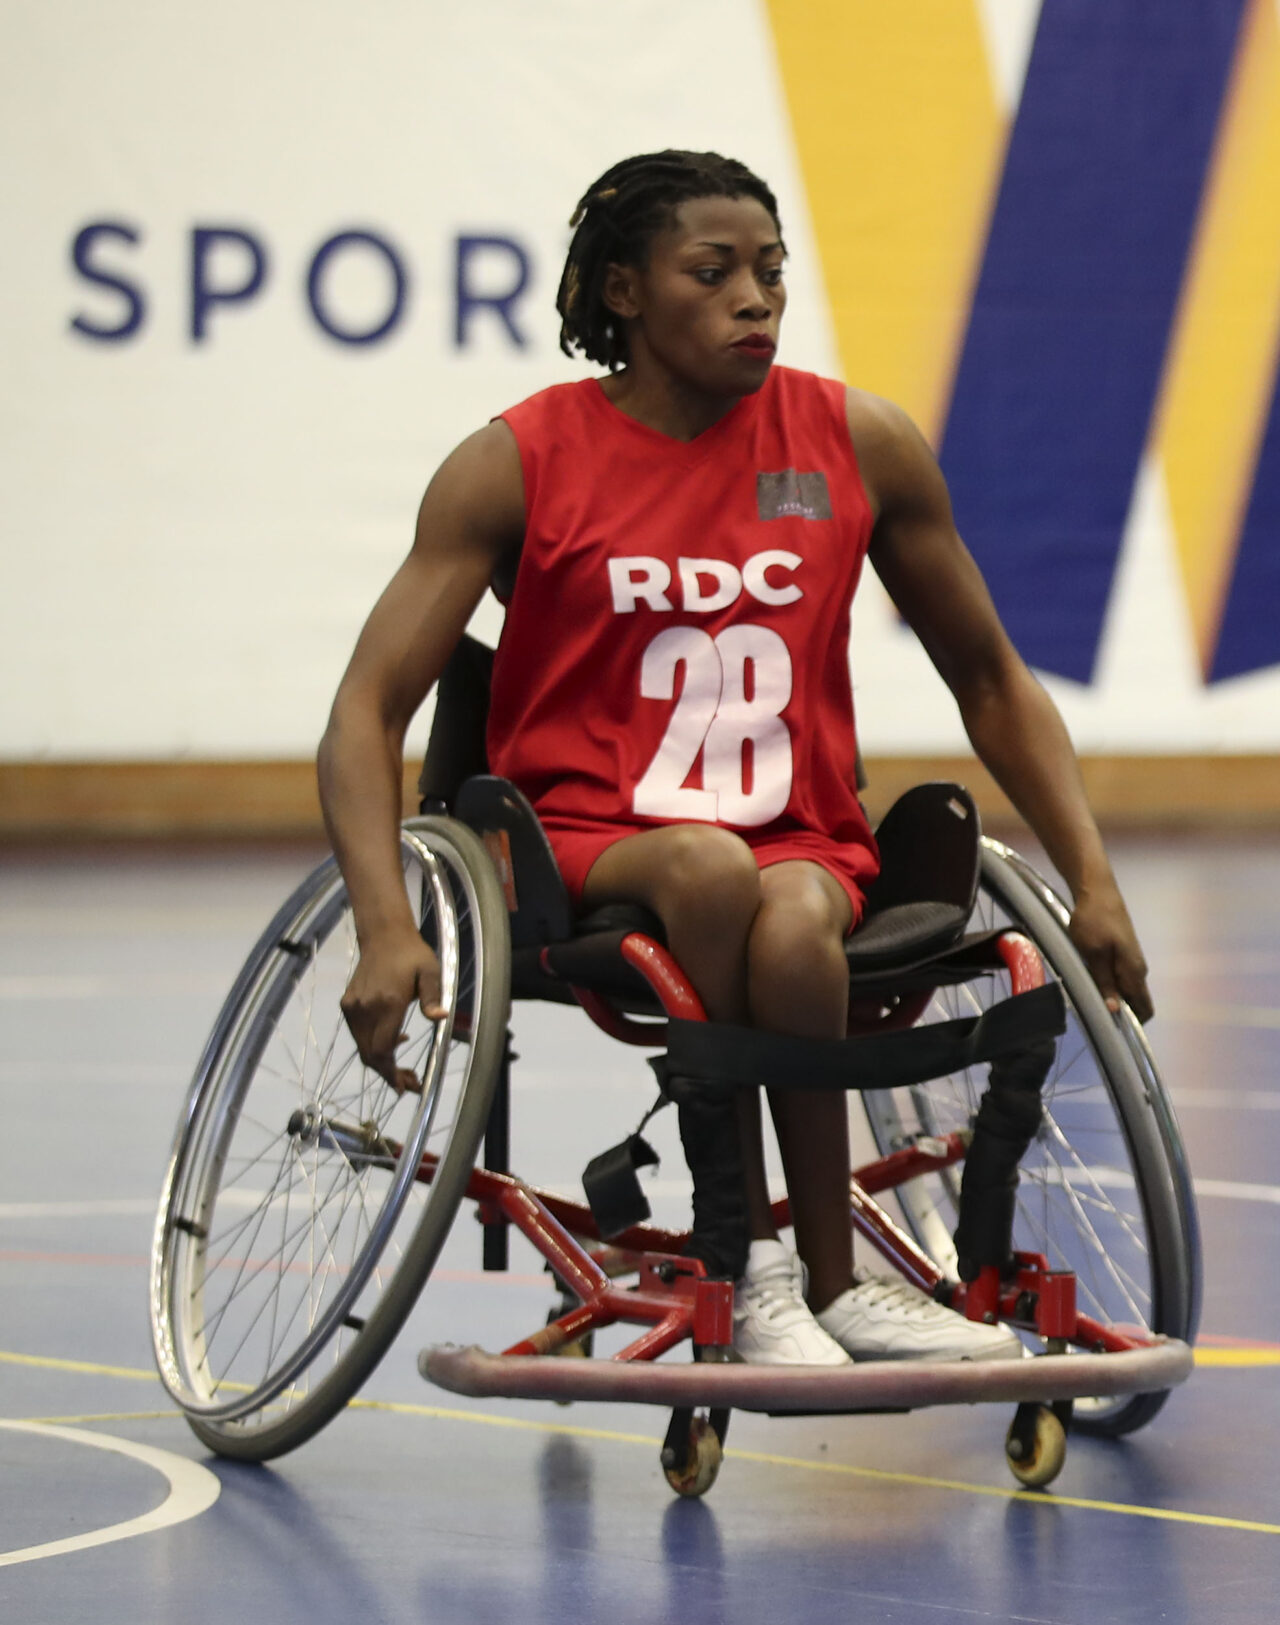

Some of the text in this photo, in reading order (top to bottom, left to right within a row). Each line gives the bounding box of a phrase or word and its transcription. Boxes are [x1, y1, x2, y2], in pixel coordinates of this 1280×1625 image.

[68, 220, 534, 350] SPOR
[607, 549, 804, 614] RDC
[633, 624, 793, 827] 28
